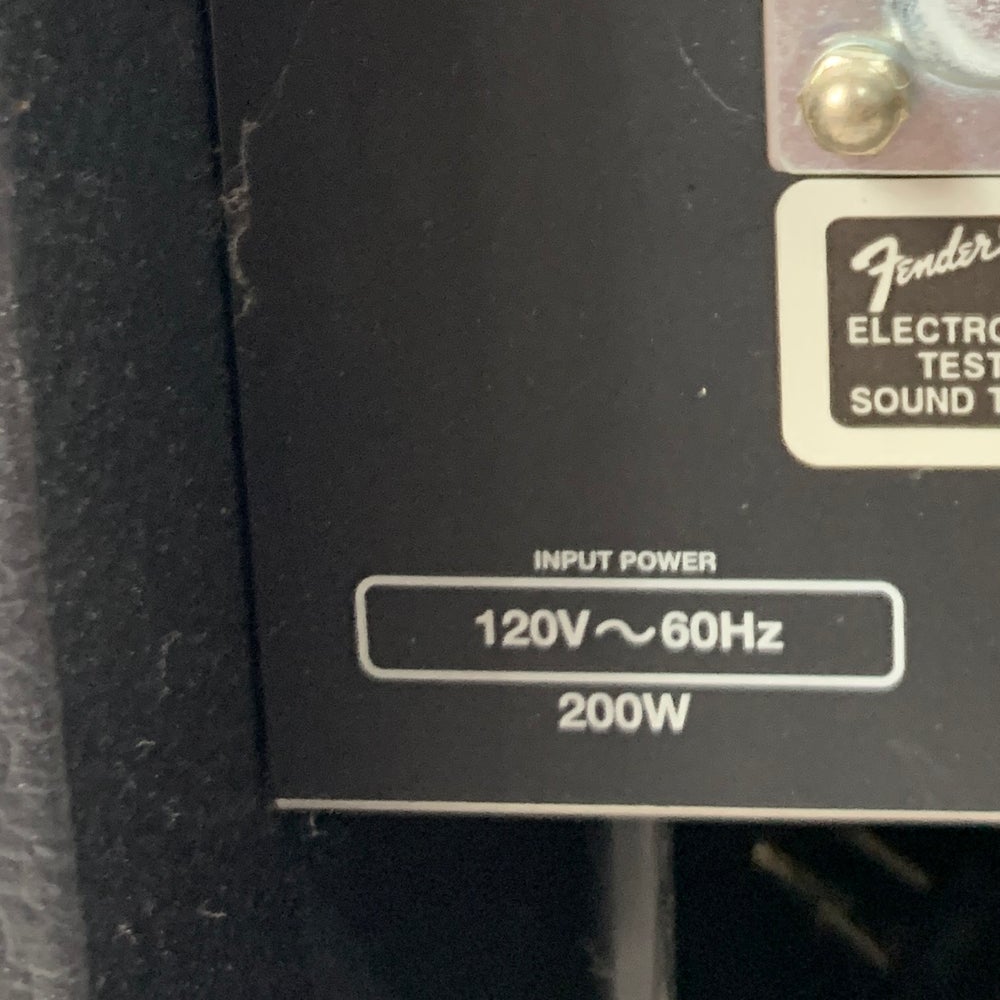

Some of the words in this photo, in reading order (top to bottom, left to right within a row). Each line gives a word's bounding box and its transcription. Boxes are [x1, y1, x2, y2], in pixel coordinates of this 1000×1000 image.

[849, 385, 976, 417] SOUND
[532, 549, 614, 572] INPUT
[619, 550, 718, 574] POWER
[557, 690, 692, 735] 200W
